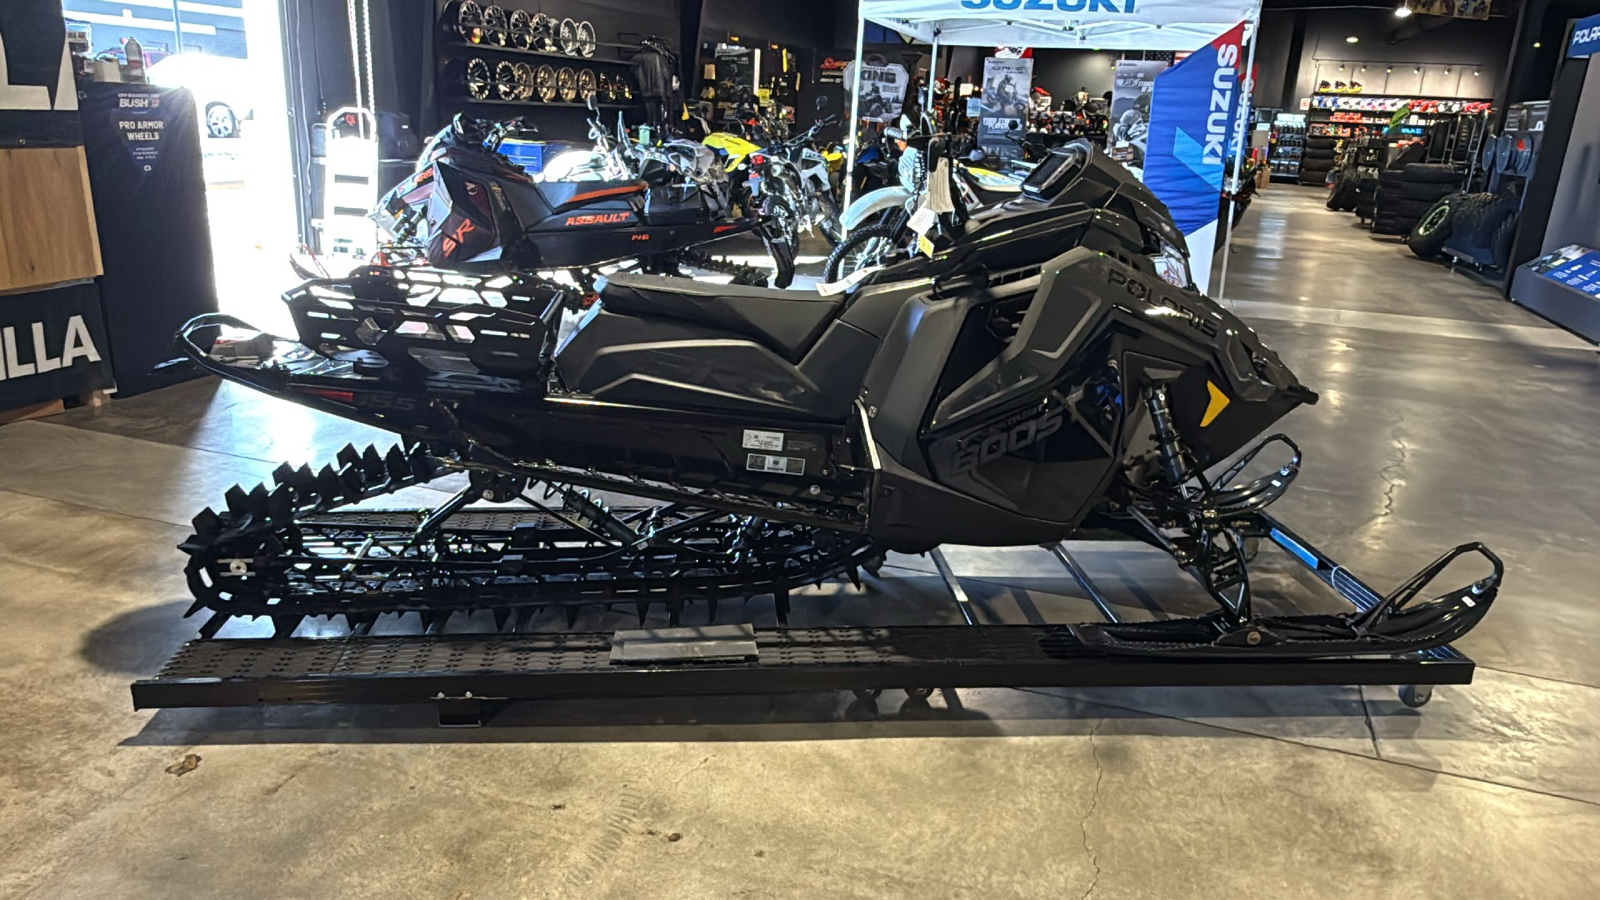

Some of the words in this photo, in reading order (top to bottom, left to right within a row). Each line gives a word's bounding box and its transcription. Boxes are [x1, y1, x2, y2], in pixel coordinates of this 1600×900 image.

[119, 98, 148, 108] BUSH
[1202, 43, 1238, 164] SUZUKI
[119, 121, 136, 130] PRO
[137, 121, 164, 130] ARMOR
[127, 132, 160, 141] WHEELS
[565, 212, 630, 226] ASSAULT
[631, 233, 649, 241] 146
[1106, 267, 1219, 339] POLARIS
